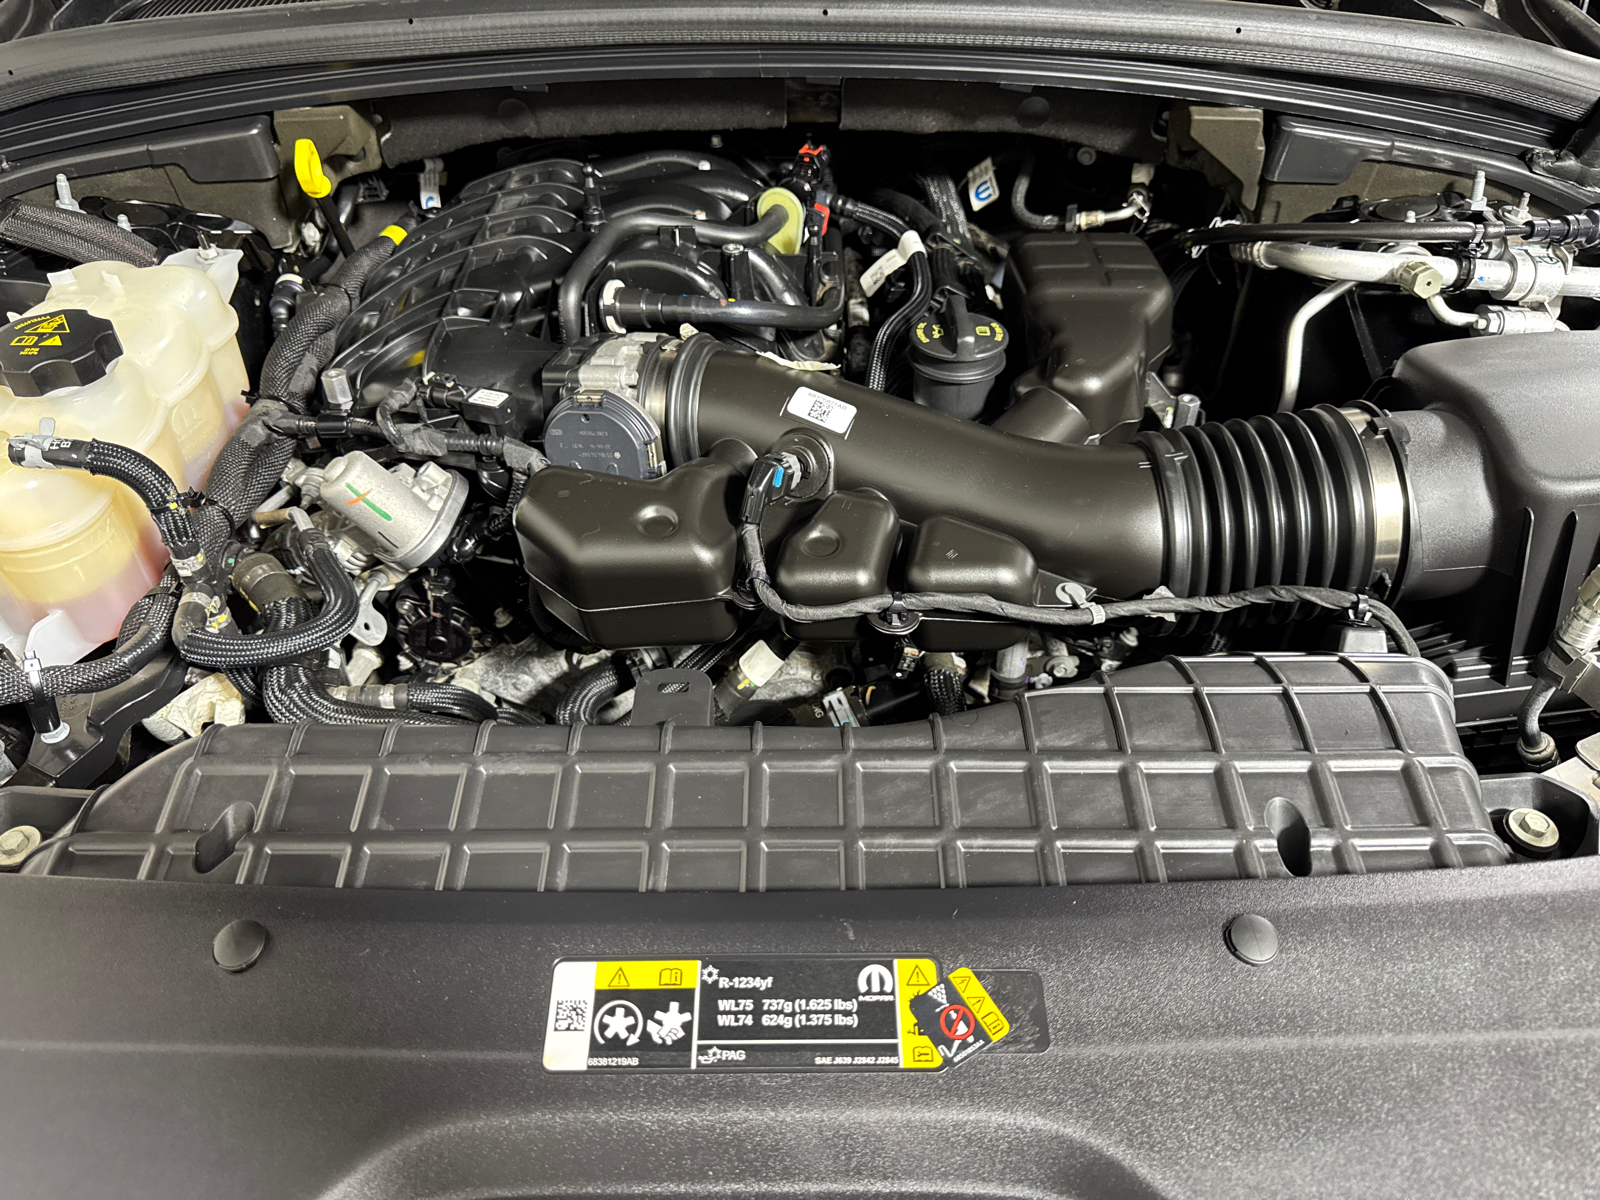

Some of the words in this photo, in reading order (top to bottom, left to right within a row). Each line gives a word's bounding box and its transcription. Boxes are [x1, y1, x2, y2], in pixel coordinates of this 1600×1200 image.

[718, 976, 774, 991] R-1234yf
[717, 999, 754, 1011] WL75
[761, 999, 793, 1013] 737g
[794, 998, 832, 1013] (1.625
[833, 998, 858, 1013] lbs)
[717, 1014, 754, 1026] WL74
[761, 1014, 793, 1028] 624g
[794, 1013, 833, 1028] (1.375
[833, 1013, 859, 1028] lbs)
[588, 1056, 640, 1066] 68381219AB
[721, 1049, 746, 1061] PAG
[814, 1056, 833, 1065] SAE
[833, 1056, 852, 1065] J639
